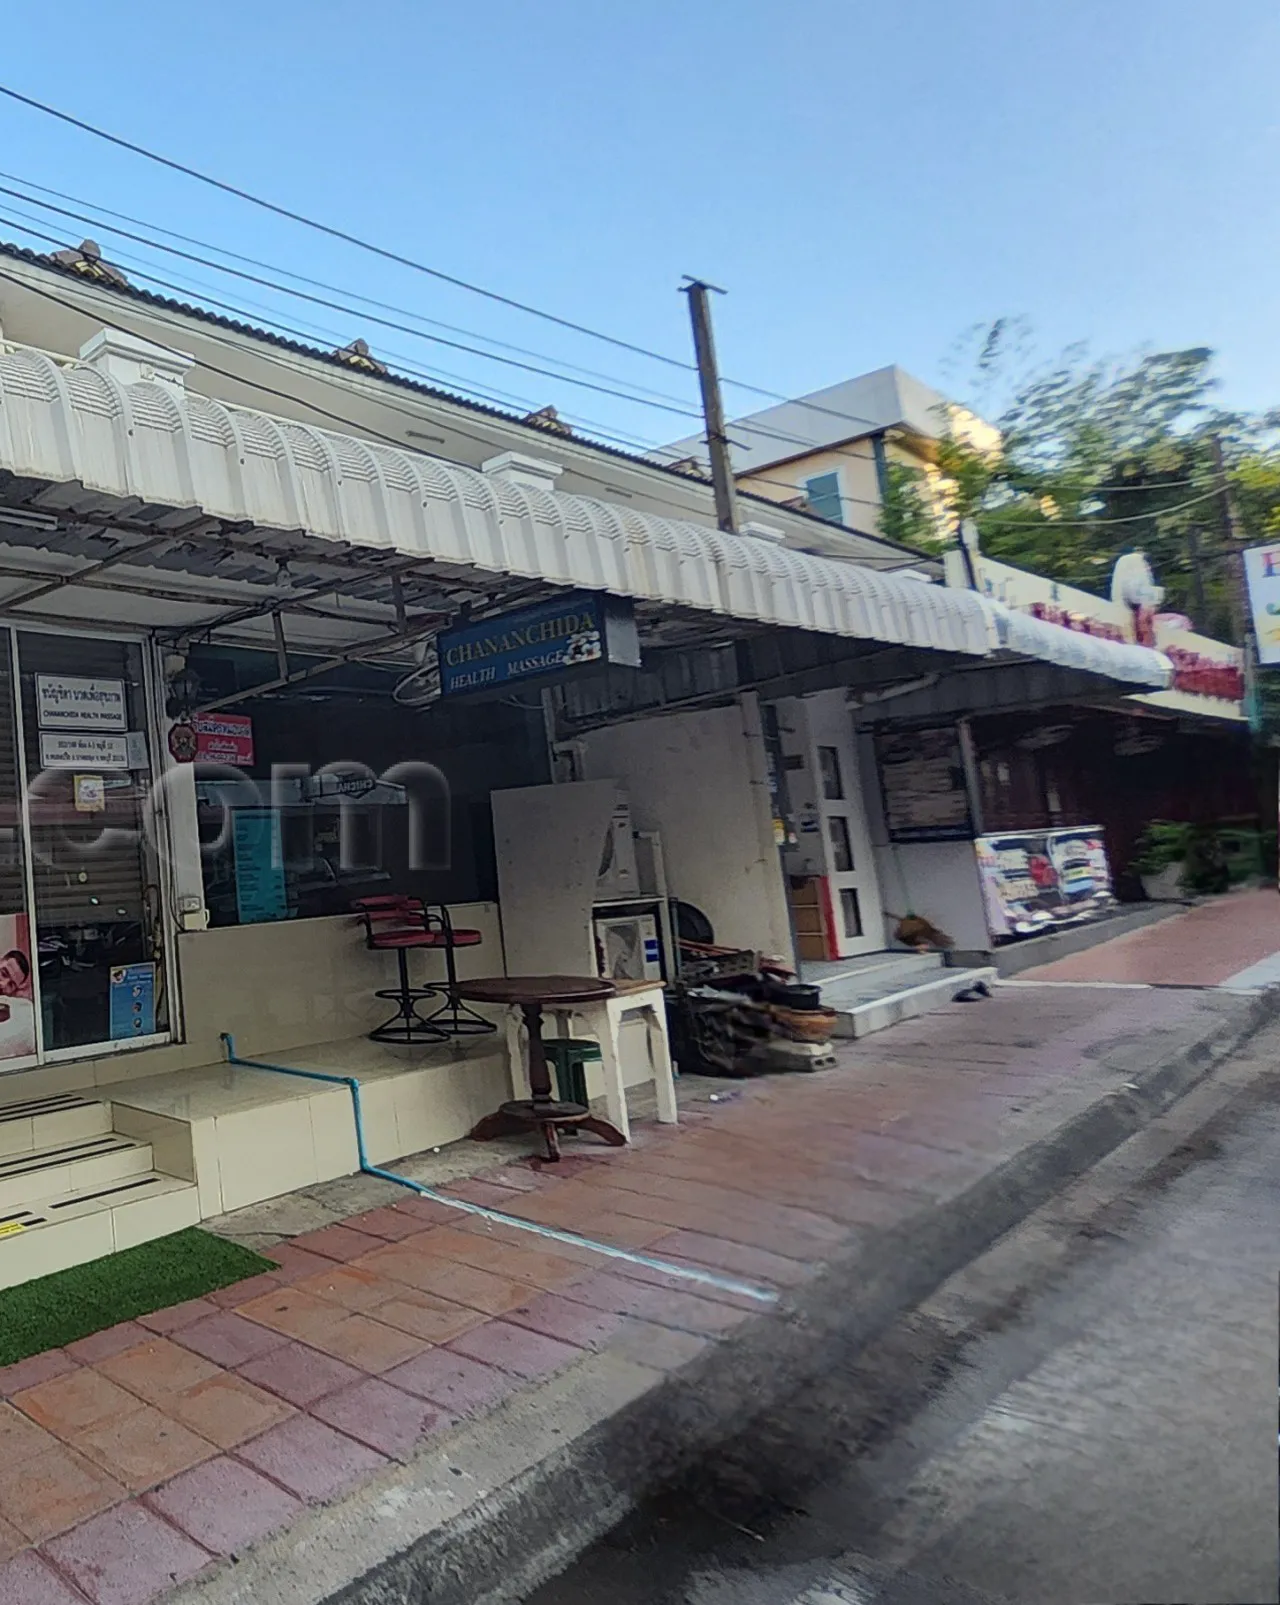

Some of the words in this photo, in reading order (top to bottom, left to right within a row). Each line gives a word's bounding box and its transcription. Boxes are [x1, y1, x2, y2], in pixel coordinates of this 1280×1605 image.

[446, 612, 595, 667] CHANANCHIDA
[450, 666, 496, 691] HEALTH
[507, 650, 565, 678] MASSAGE
